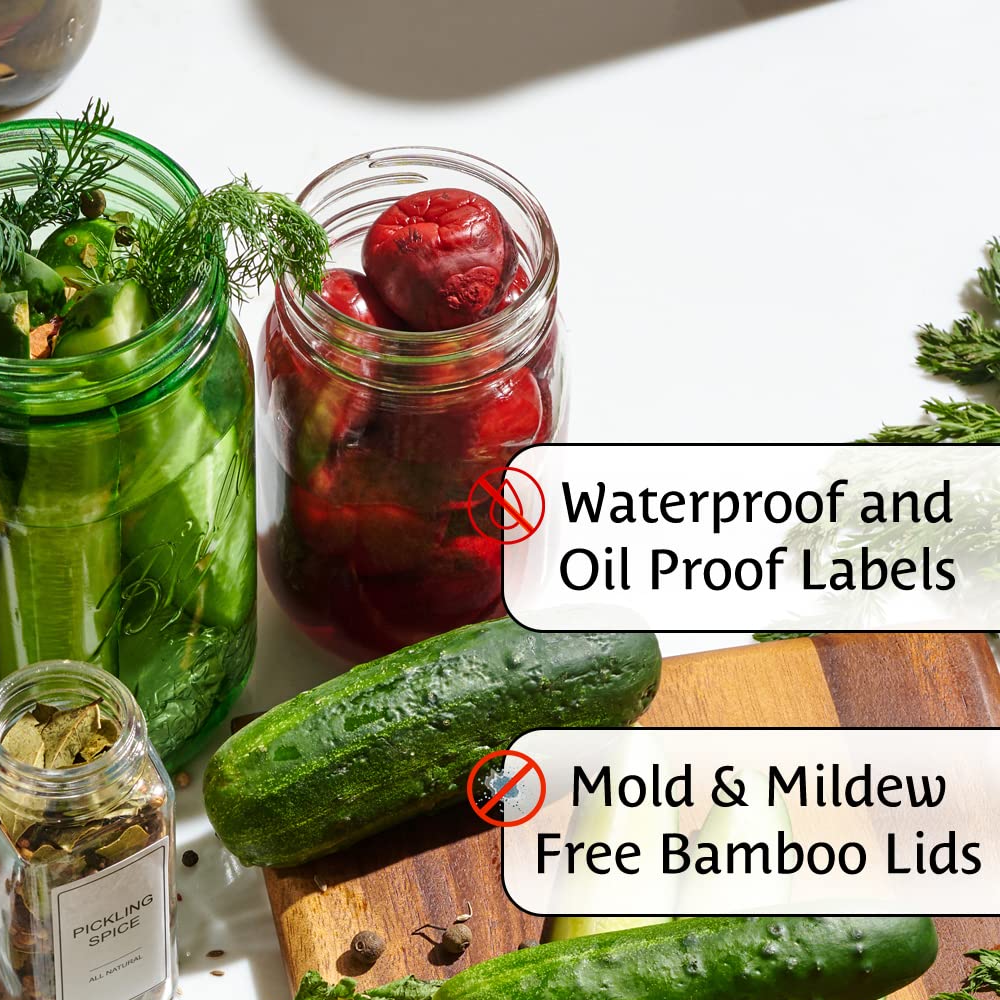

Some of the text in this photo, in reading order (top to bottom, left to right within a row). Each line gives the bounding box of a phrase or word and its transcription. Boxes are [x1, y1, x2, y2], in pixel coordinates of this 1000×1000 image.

[73, 894, 154, 938] PICKLING
[88, 915, 141, 947] SPICE
[88, 955, 143, 983] ALL NATURAL
